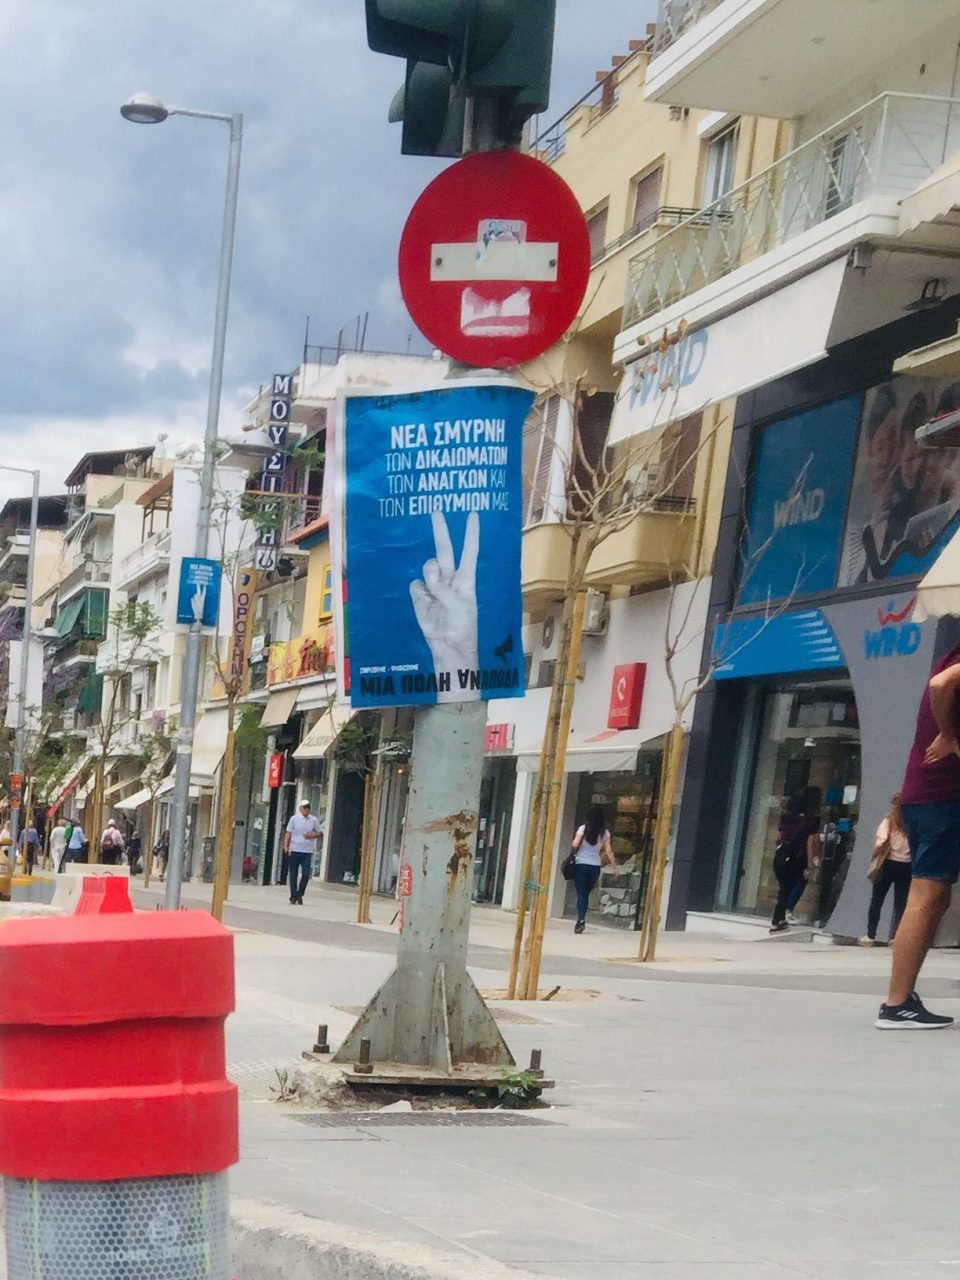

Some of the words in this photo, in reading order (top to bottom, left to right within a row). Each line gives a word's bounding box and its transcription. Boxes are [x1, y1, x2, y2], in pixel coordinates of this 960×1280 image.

[391, 423, 428, 449] ΝΕΑ
[434, 419, 505, 446] ΣΜΥΡΝΗ
[385, 451, 411, 472] ΤΩΝ
[415, 446, 508, 470] ΔΙΚΑΙΩΜΑΤΩΝ
[387, 474, 414, 494] ΤΩΝ
[418, 469, 487, 492] ΑΝΑΓΚΩΝ
[491, 469, 506, 488] ΚΑΙ
[379, 496, 405, 518] ΤΩΝ
[409, 492, 490, 515] ΕΠΙΘΥΜΙΩΝ
[863, 622, 921, 660] WIND
[360, 675, 395, 697] ΜΙΑ
